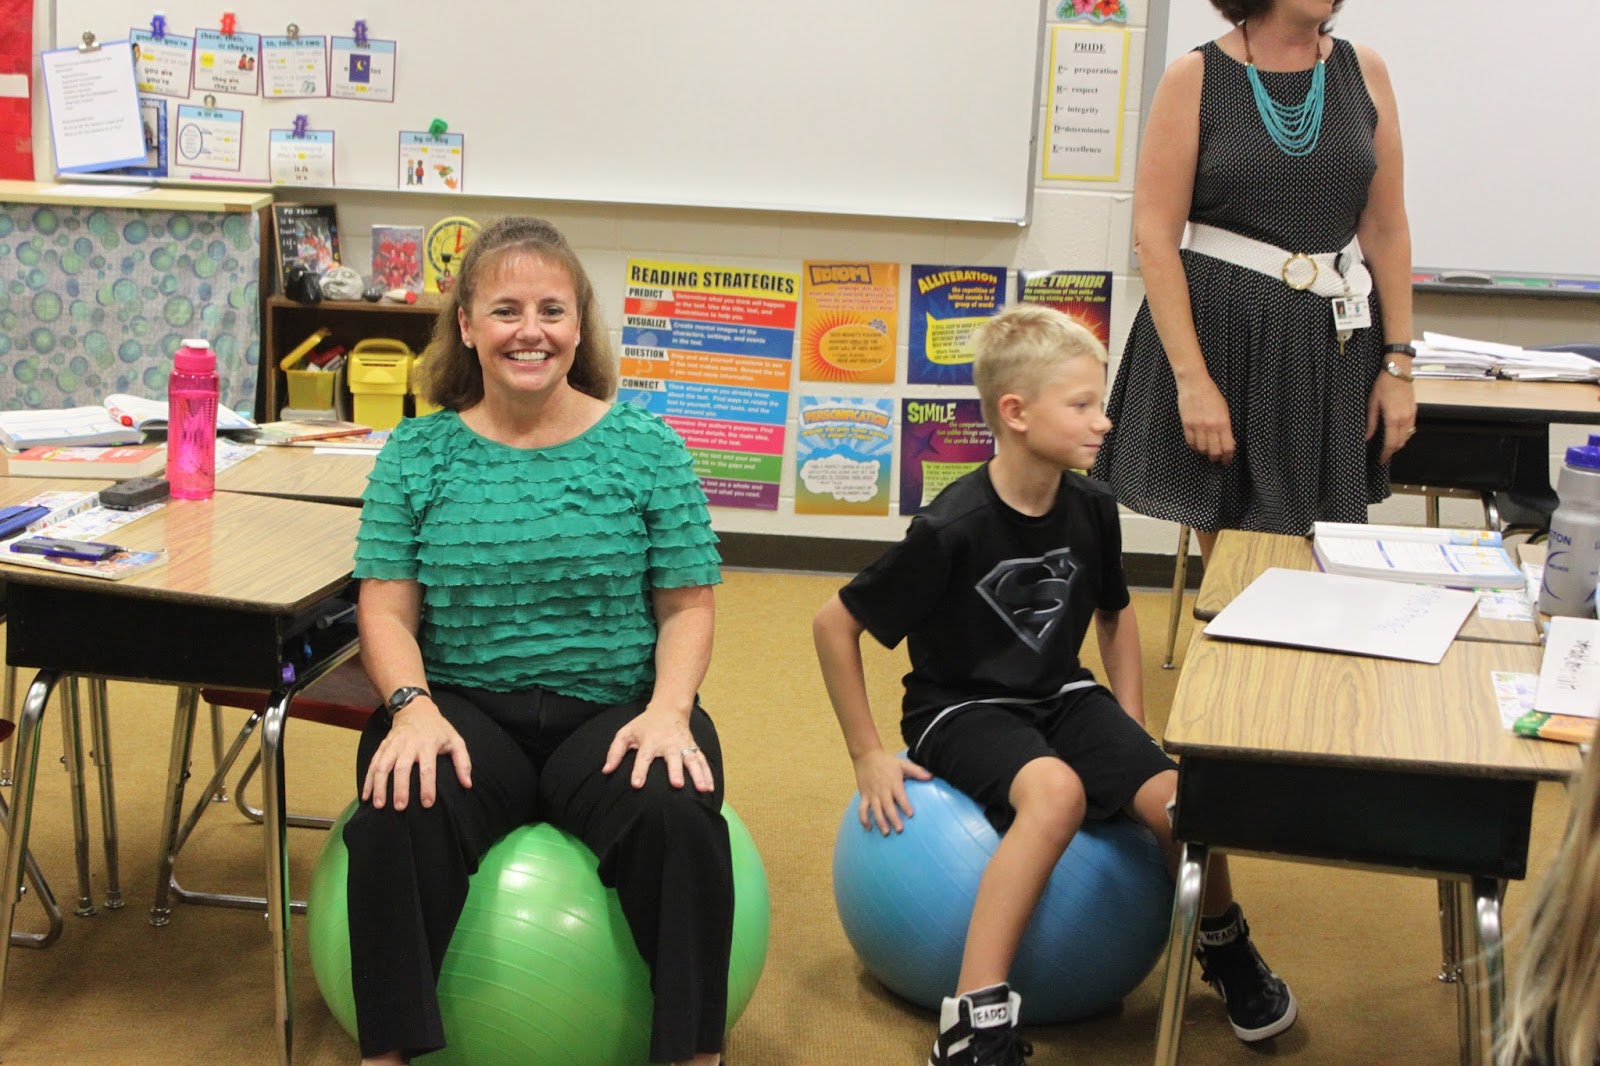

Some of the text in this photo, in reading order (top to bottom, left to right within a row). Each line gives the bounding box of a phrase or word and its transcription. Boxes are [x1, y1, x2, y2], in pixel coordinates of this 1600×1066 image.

[1074, 42, 1106, 51] PRIDE
[1074, 67, 1118, 75] preparation
[1072, 87, 1098, 95] respect
[1068, 106, 1099, 114] integrity
[1065, 145, 1102, 154] excellence
[632, 266, 794, 294] READING STRATEGIES
[810, 265, 872, 286] IDIOM
[1025, 274, 1106, 288] METAPHOR
[918, 271, 998, 294] ALLITERATION
[630, 288, 663, 299] PREDICT
[676, 293, 706, 301] Determine
[628, 316, 666, 328] VISUALIZE
[624, 347, 664, 359] QUESTION
[622, 378, 658, 390] CONNECT
[802, 408, 891, 430] PERSONIFICATION
[908, 402, 957, 424] SIMILE
